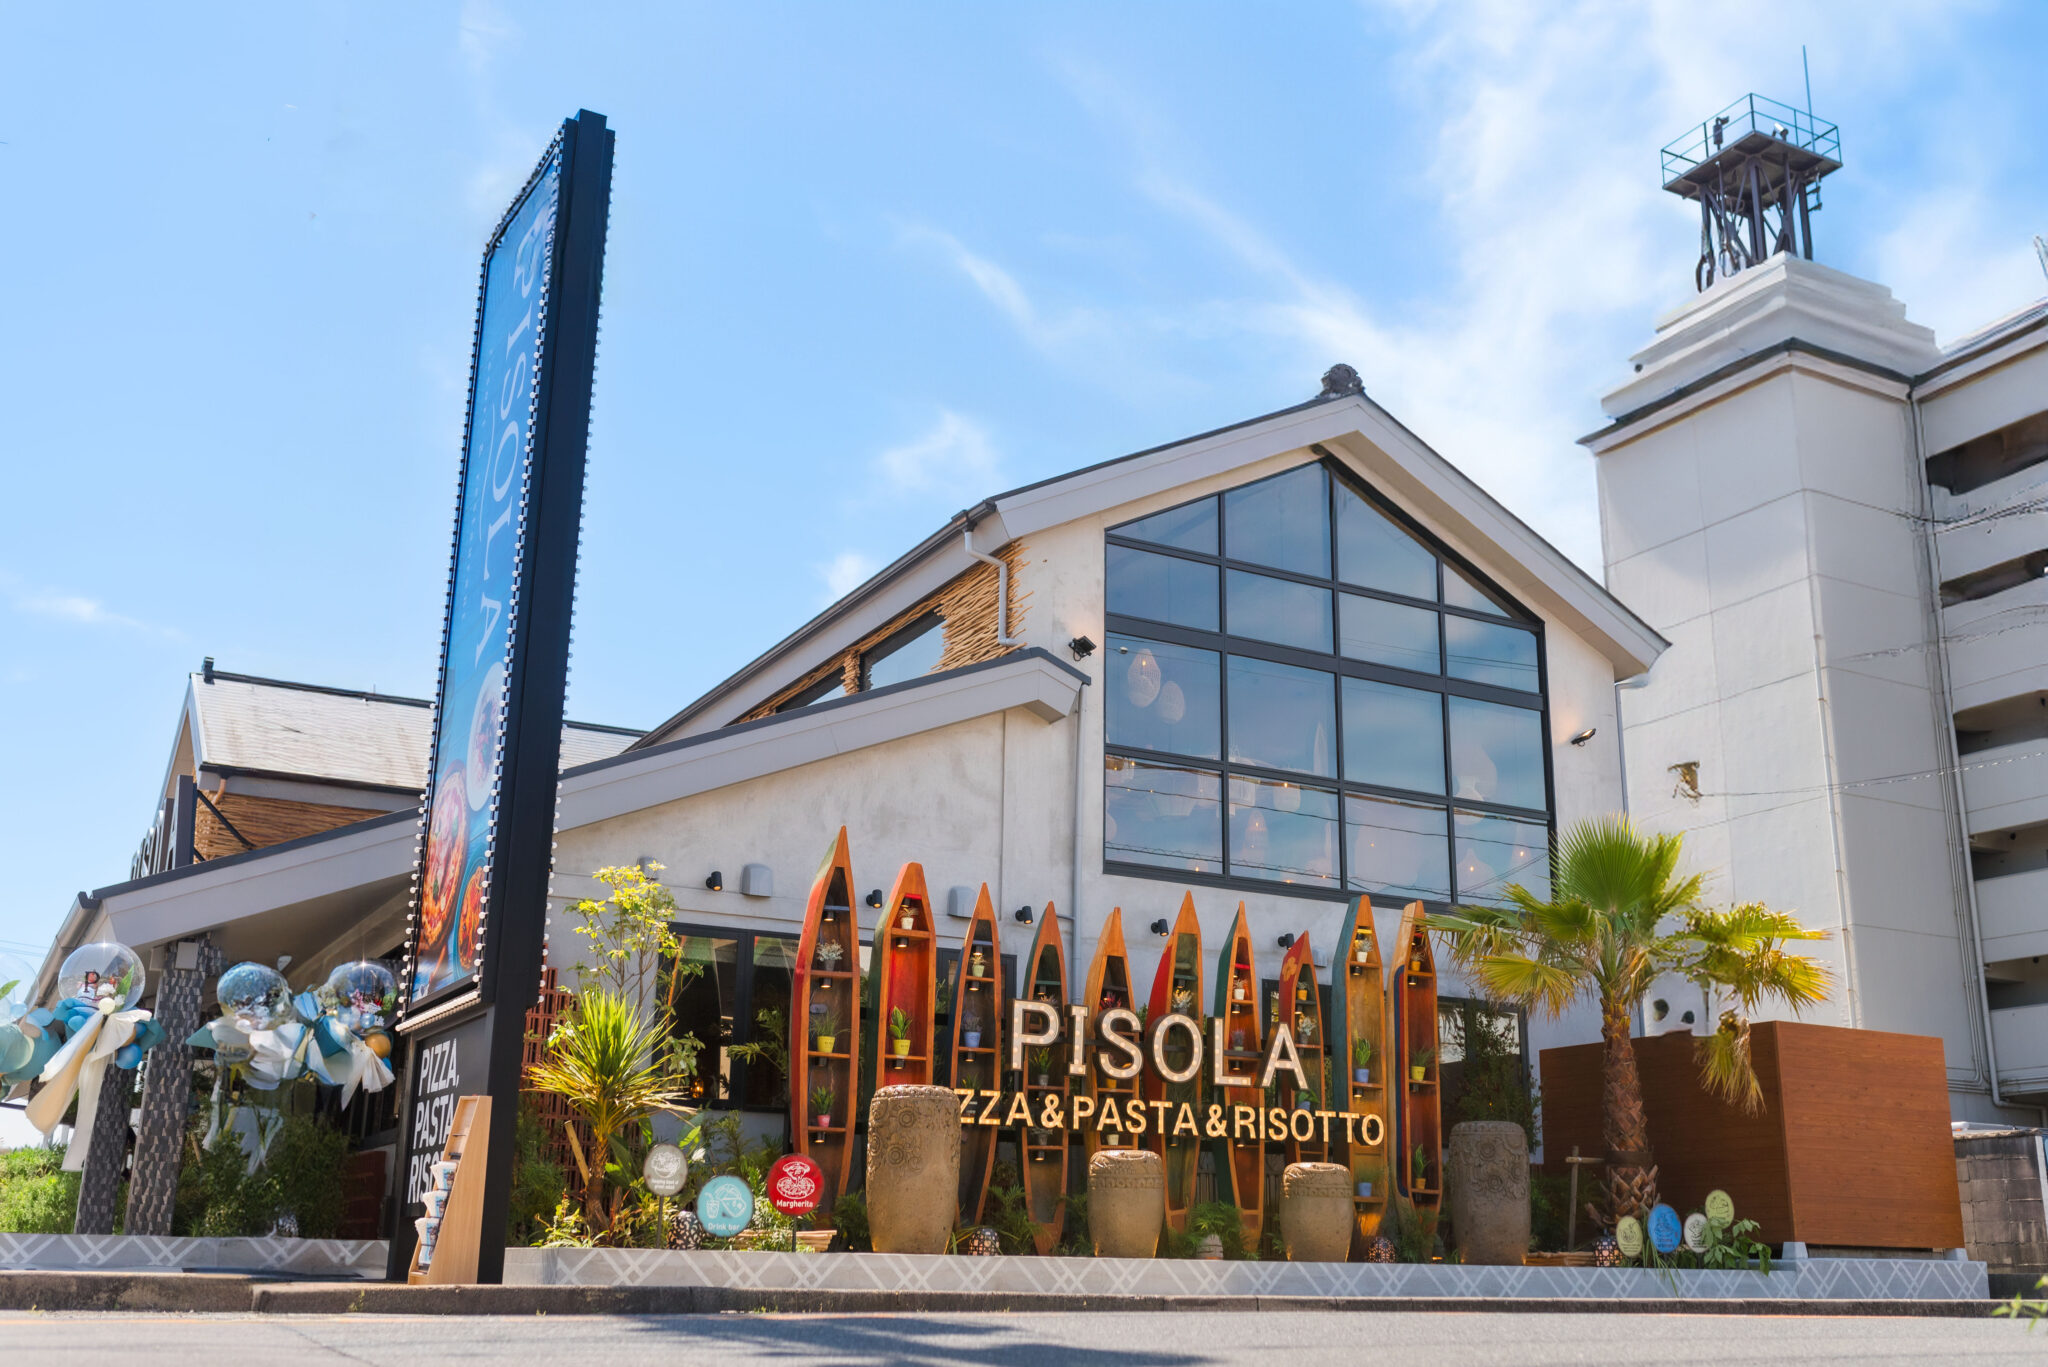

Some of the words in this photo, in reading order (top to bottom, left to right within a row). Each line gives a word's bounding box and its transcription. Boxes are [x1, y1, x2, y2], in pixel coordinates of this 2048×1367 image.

[474, 202, 550, 669] PISOLA
[418, 1038, 460, 1096] PIZZA,
[1011, 999, 1309, 1090] PISOLA
[707, 1222, 726, 1231] Drink
[728, 1222, 741, 1231] bar
[776, 1199, 814, 1209] Margherita
